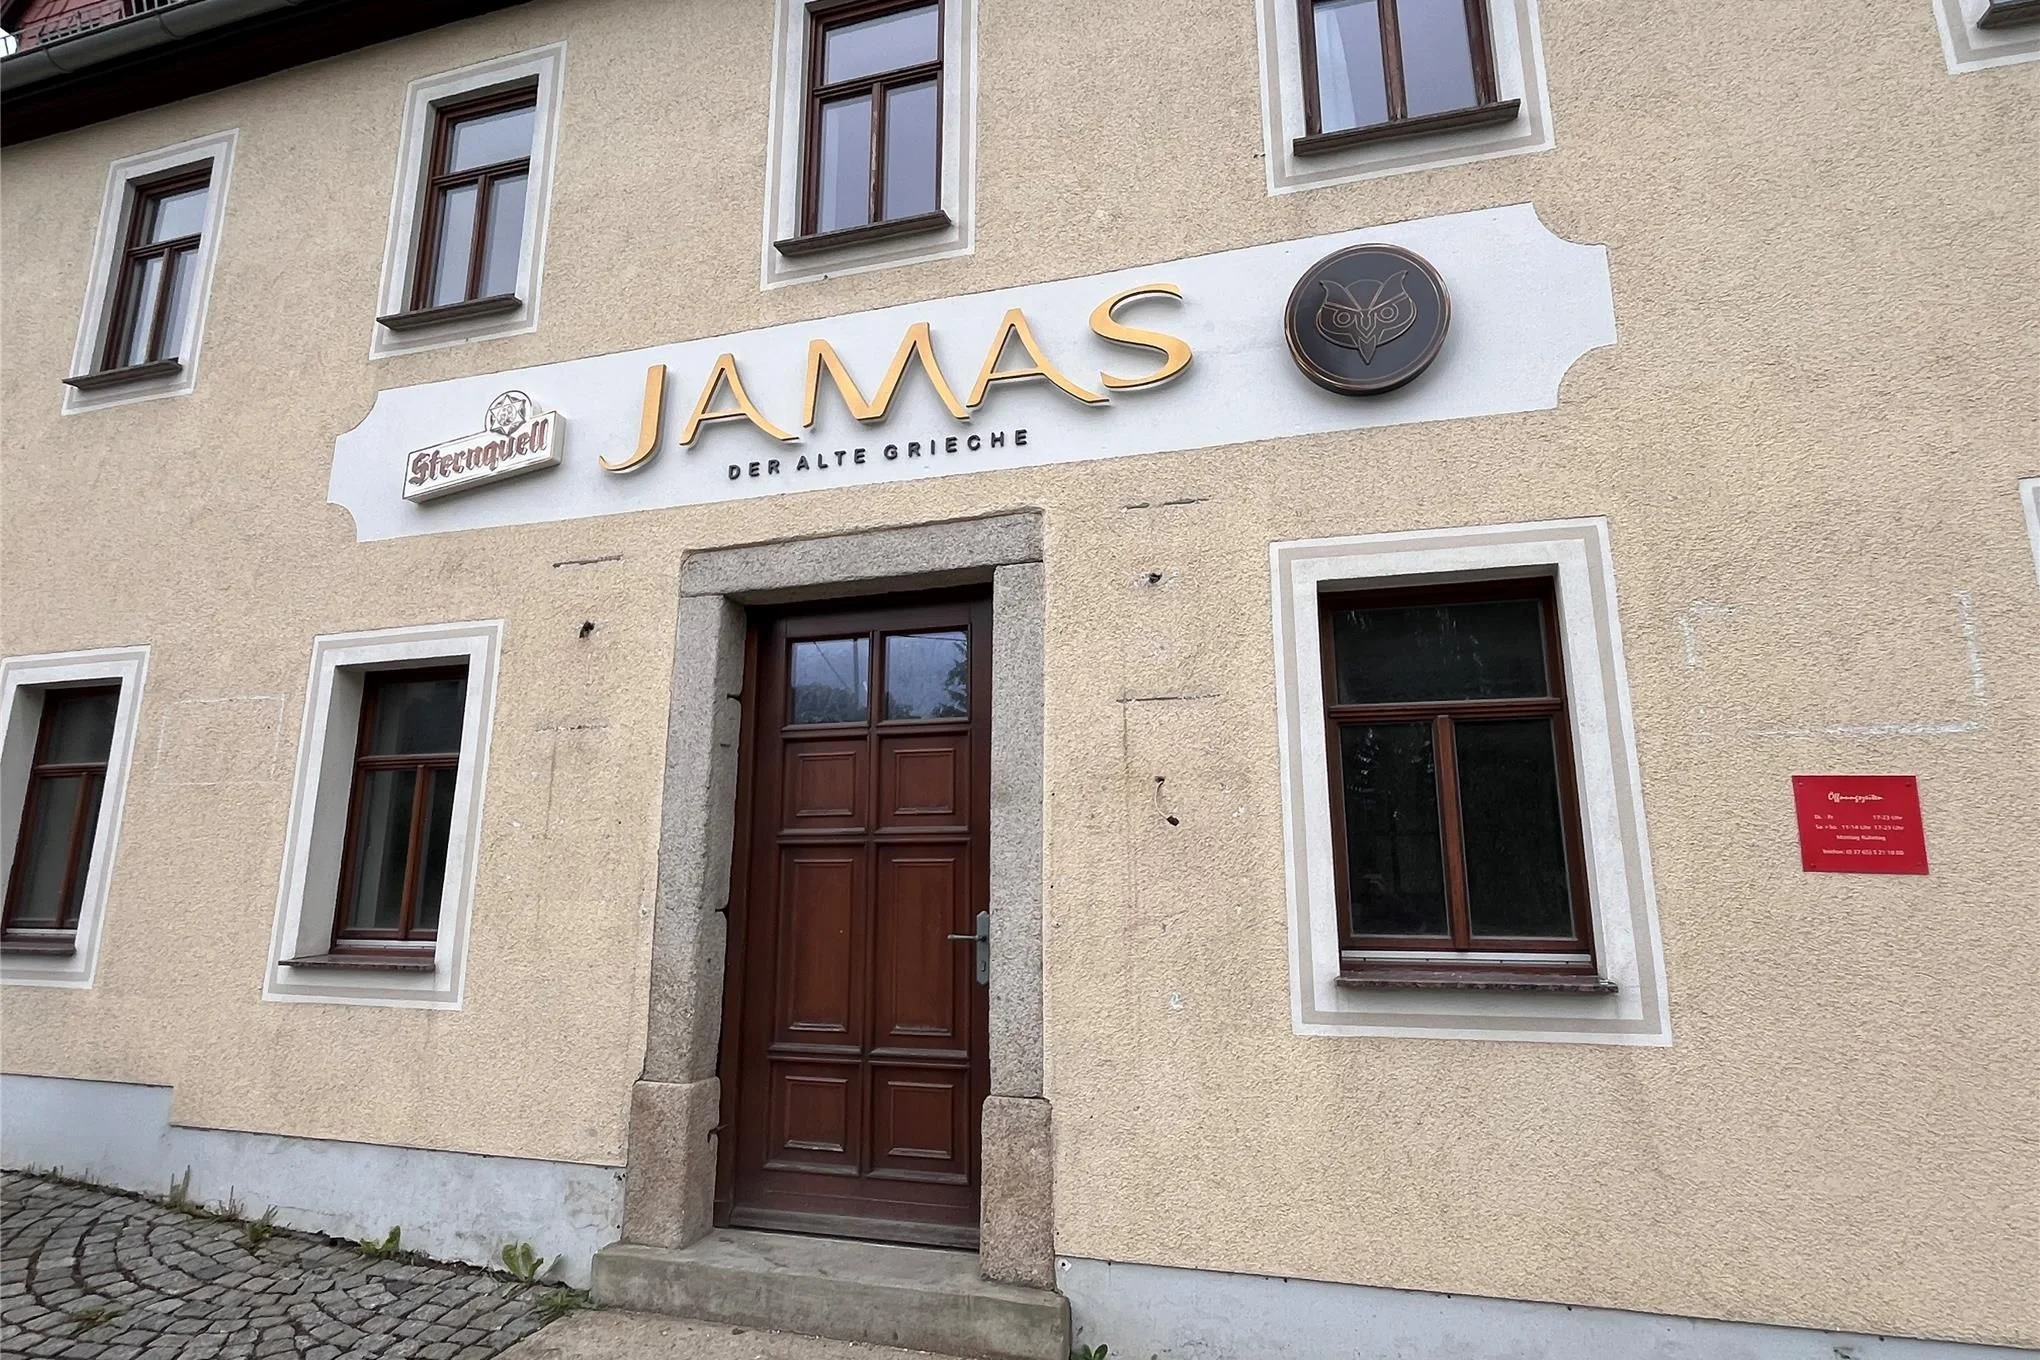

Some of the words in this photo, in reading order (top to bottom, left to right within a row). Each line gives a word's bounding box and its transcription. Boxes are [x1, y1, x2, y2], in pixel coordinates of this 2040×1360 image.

[600, 283, 1193, 472] JAMAS
[408, 418, 549, 486] Sternquell
[728, 459, 780, 480] DER
[797, 450, 866, 471] ALTE
[883, 429, 1028, 460] GRIECHE
